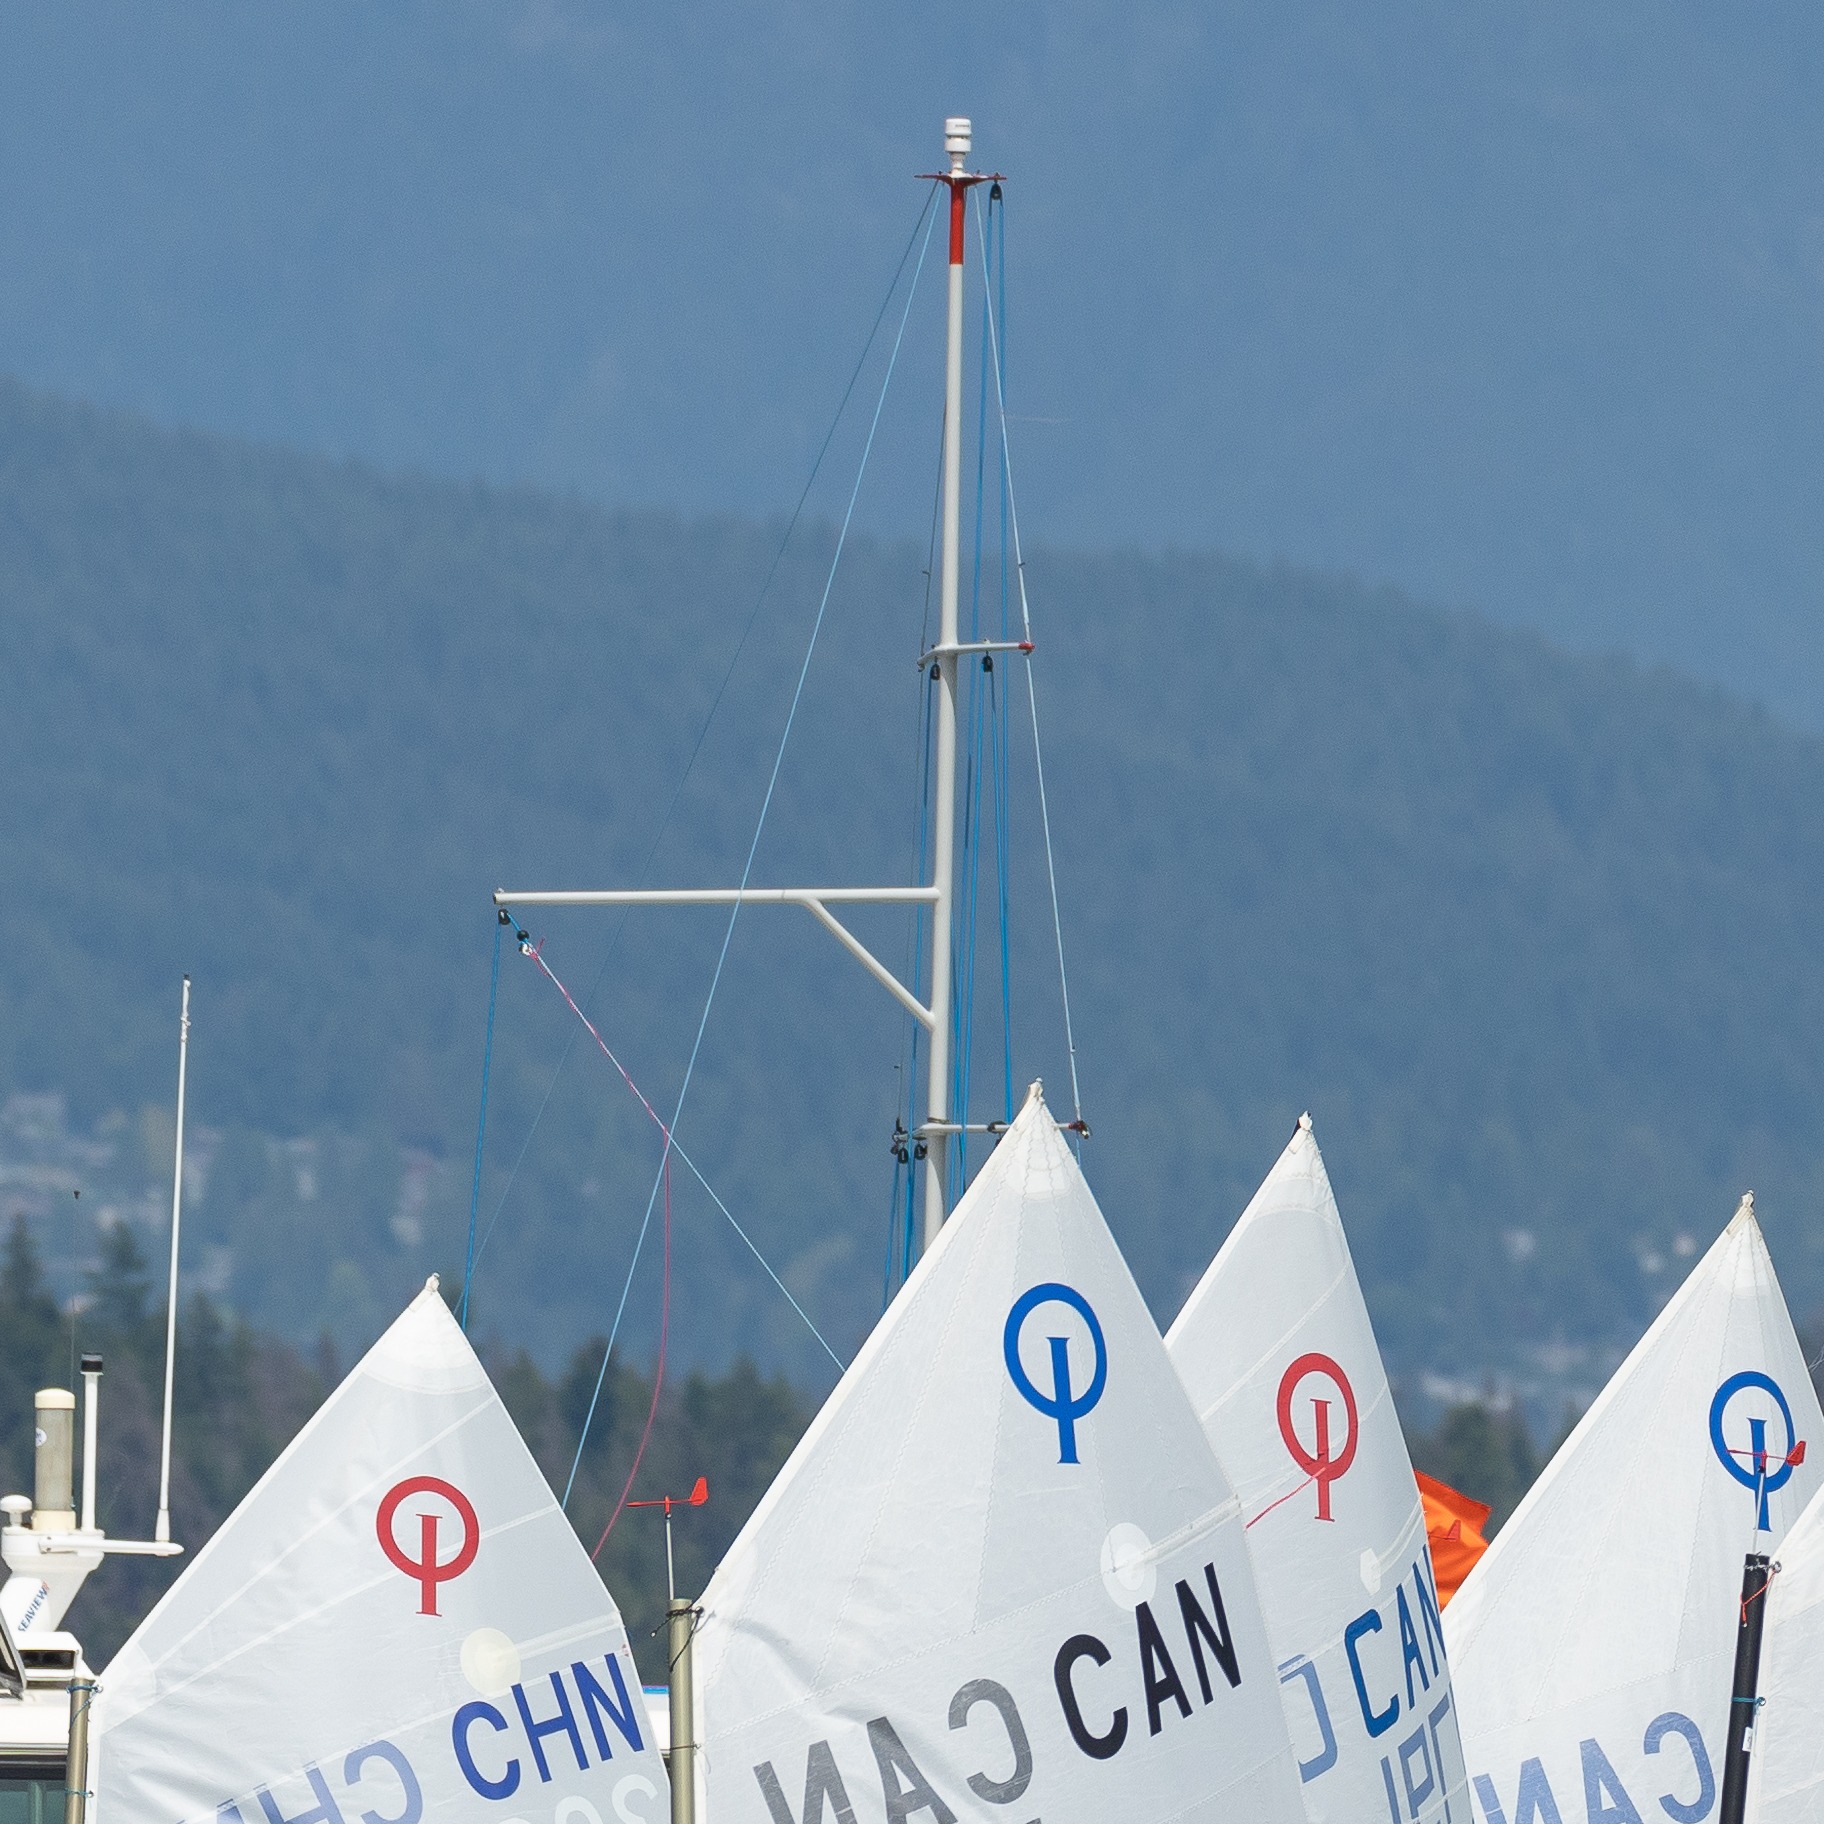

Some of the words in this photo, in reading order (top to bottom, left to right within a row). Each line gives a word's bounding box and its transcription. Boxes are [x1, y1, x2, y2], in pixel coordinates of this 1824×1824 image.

[17, 1585, 49, 1632] SEAVIEW
[1053, 1562, 1243, 1760] CAN
[451, 1653, 645, 1800] CHN
